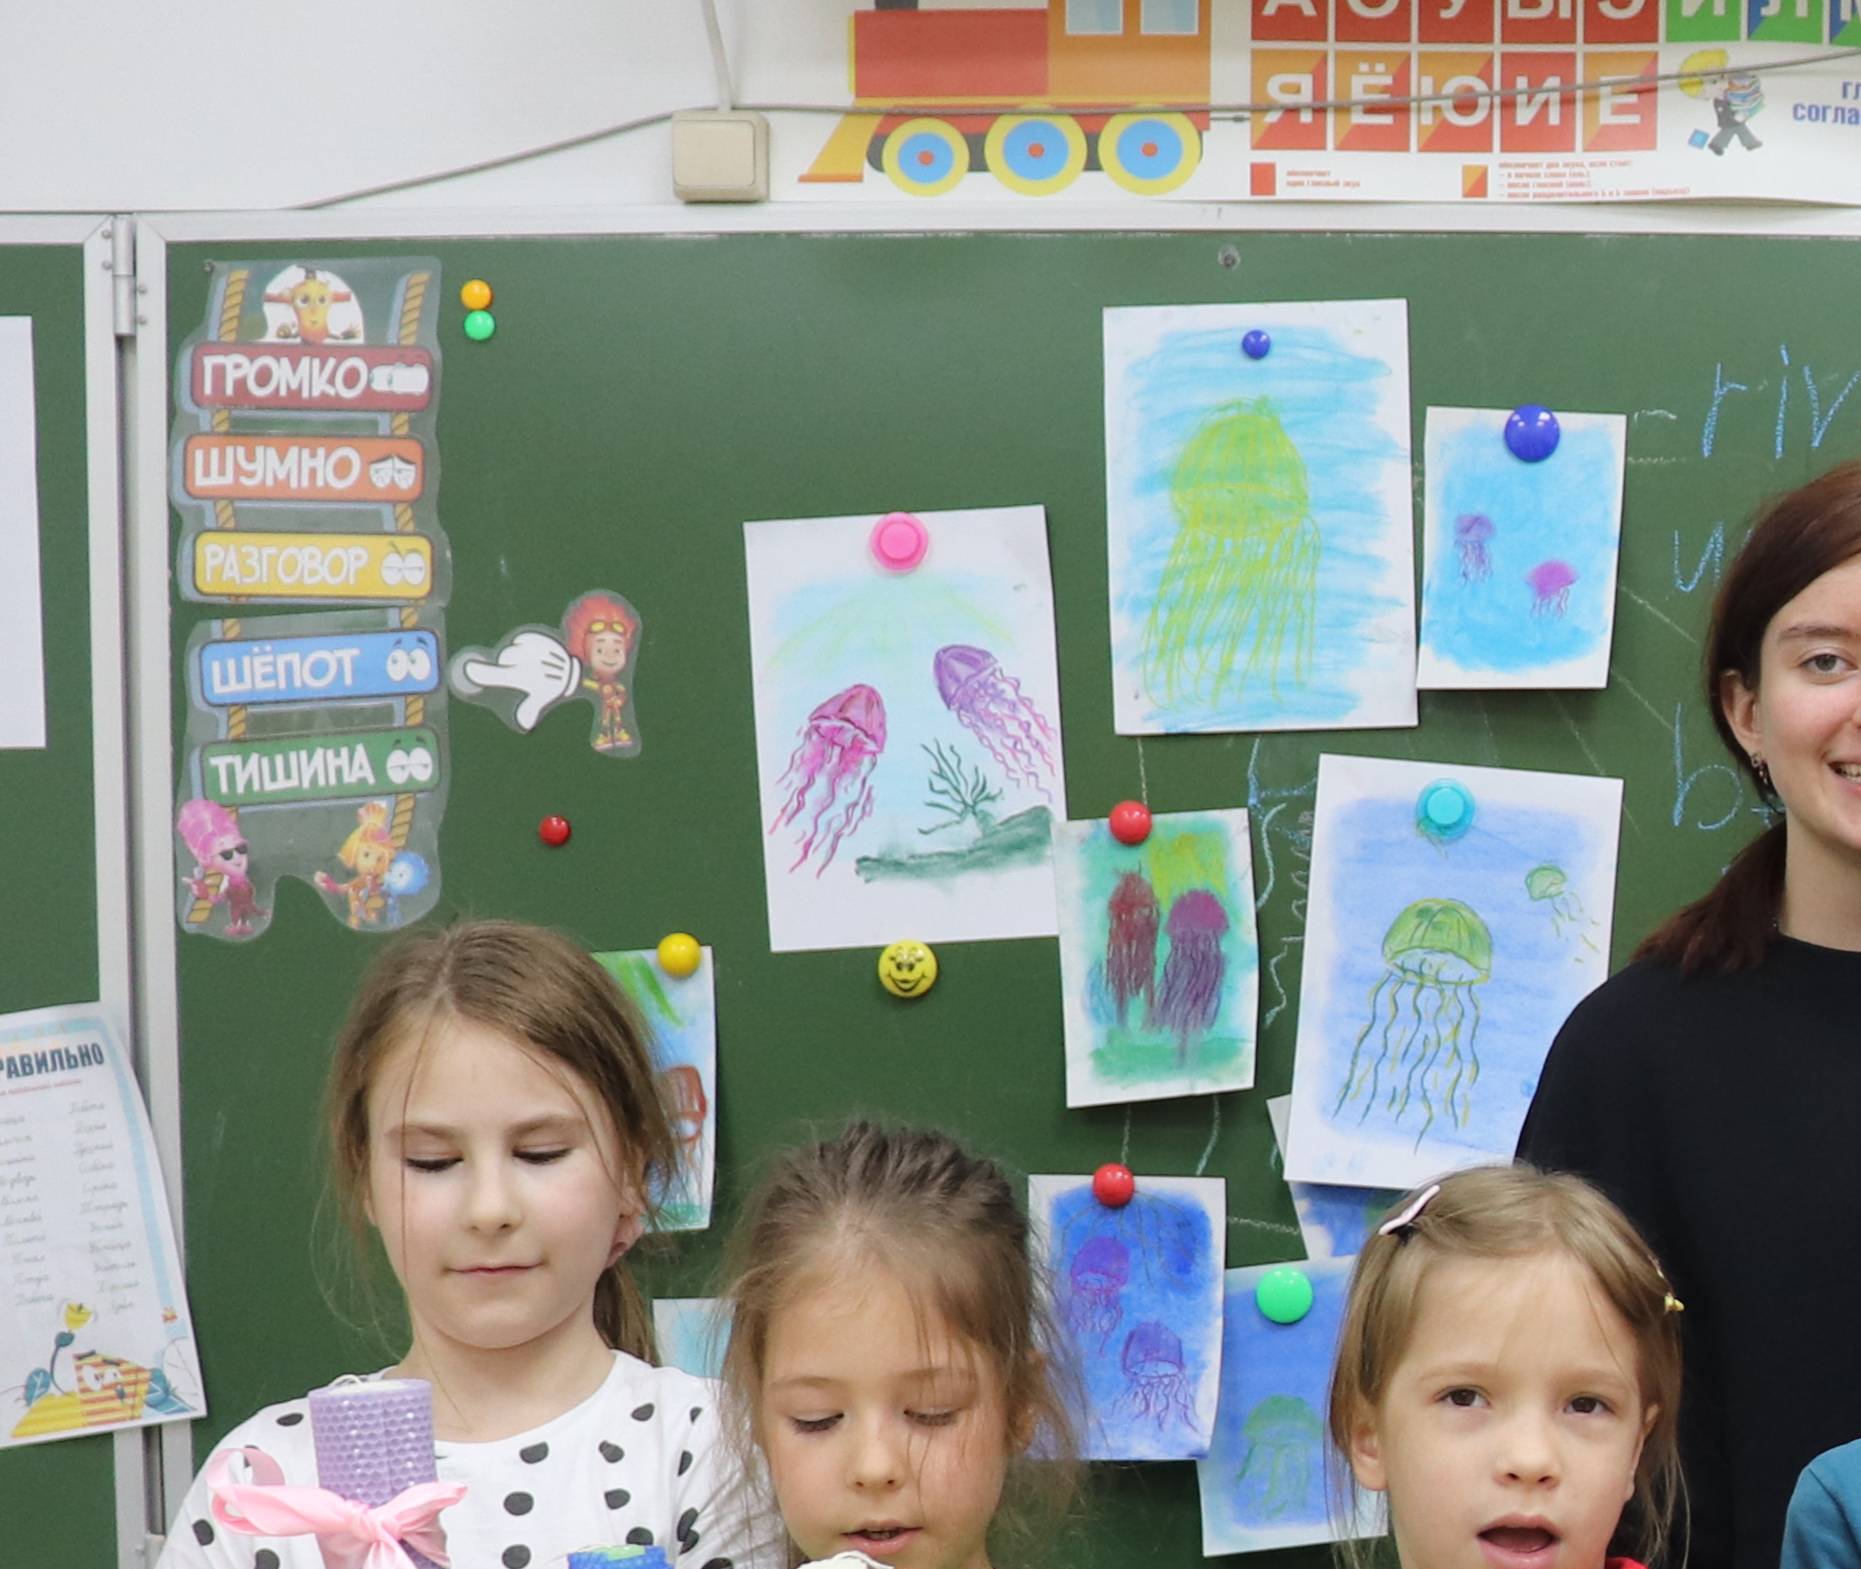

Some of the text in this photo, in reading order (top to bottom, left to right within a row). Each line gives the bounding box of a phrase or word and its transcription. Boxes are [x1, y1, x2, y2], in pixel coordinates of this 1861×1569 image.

[202, 353, 369, 399] ГРОМКО
[193, 444, 363, 490] ШУМНО
[202, 542, 370, 586] РАЗГОВОР
[210, 645, 361, 695] ШЁПОТ
[208, 742, 376, 795] ТИШИНА
